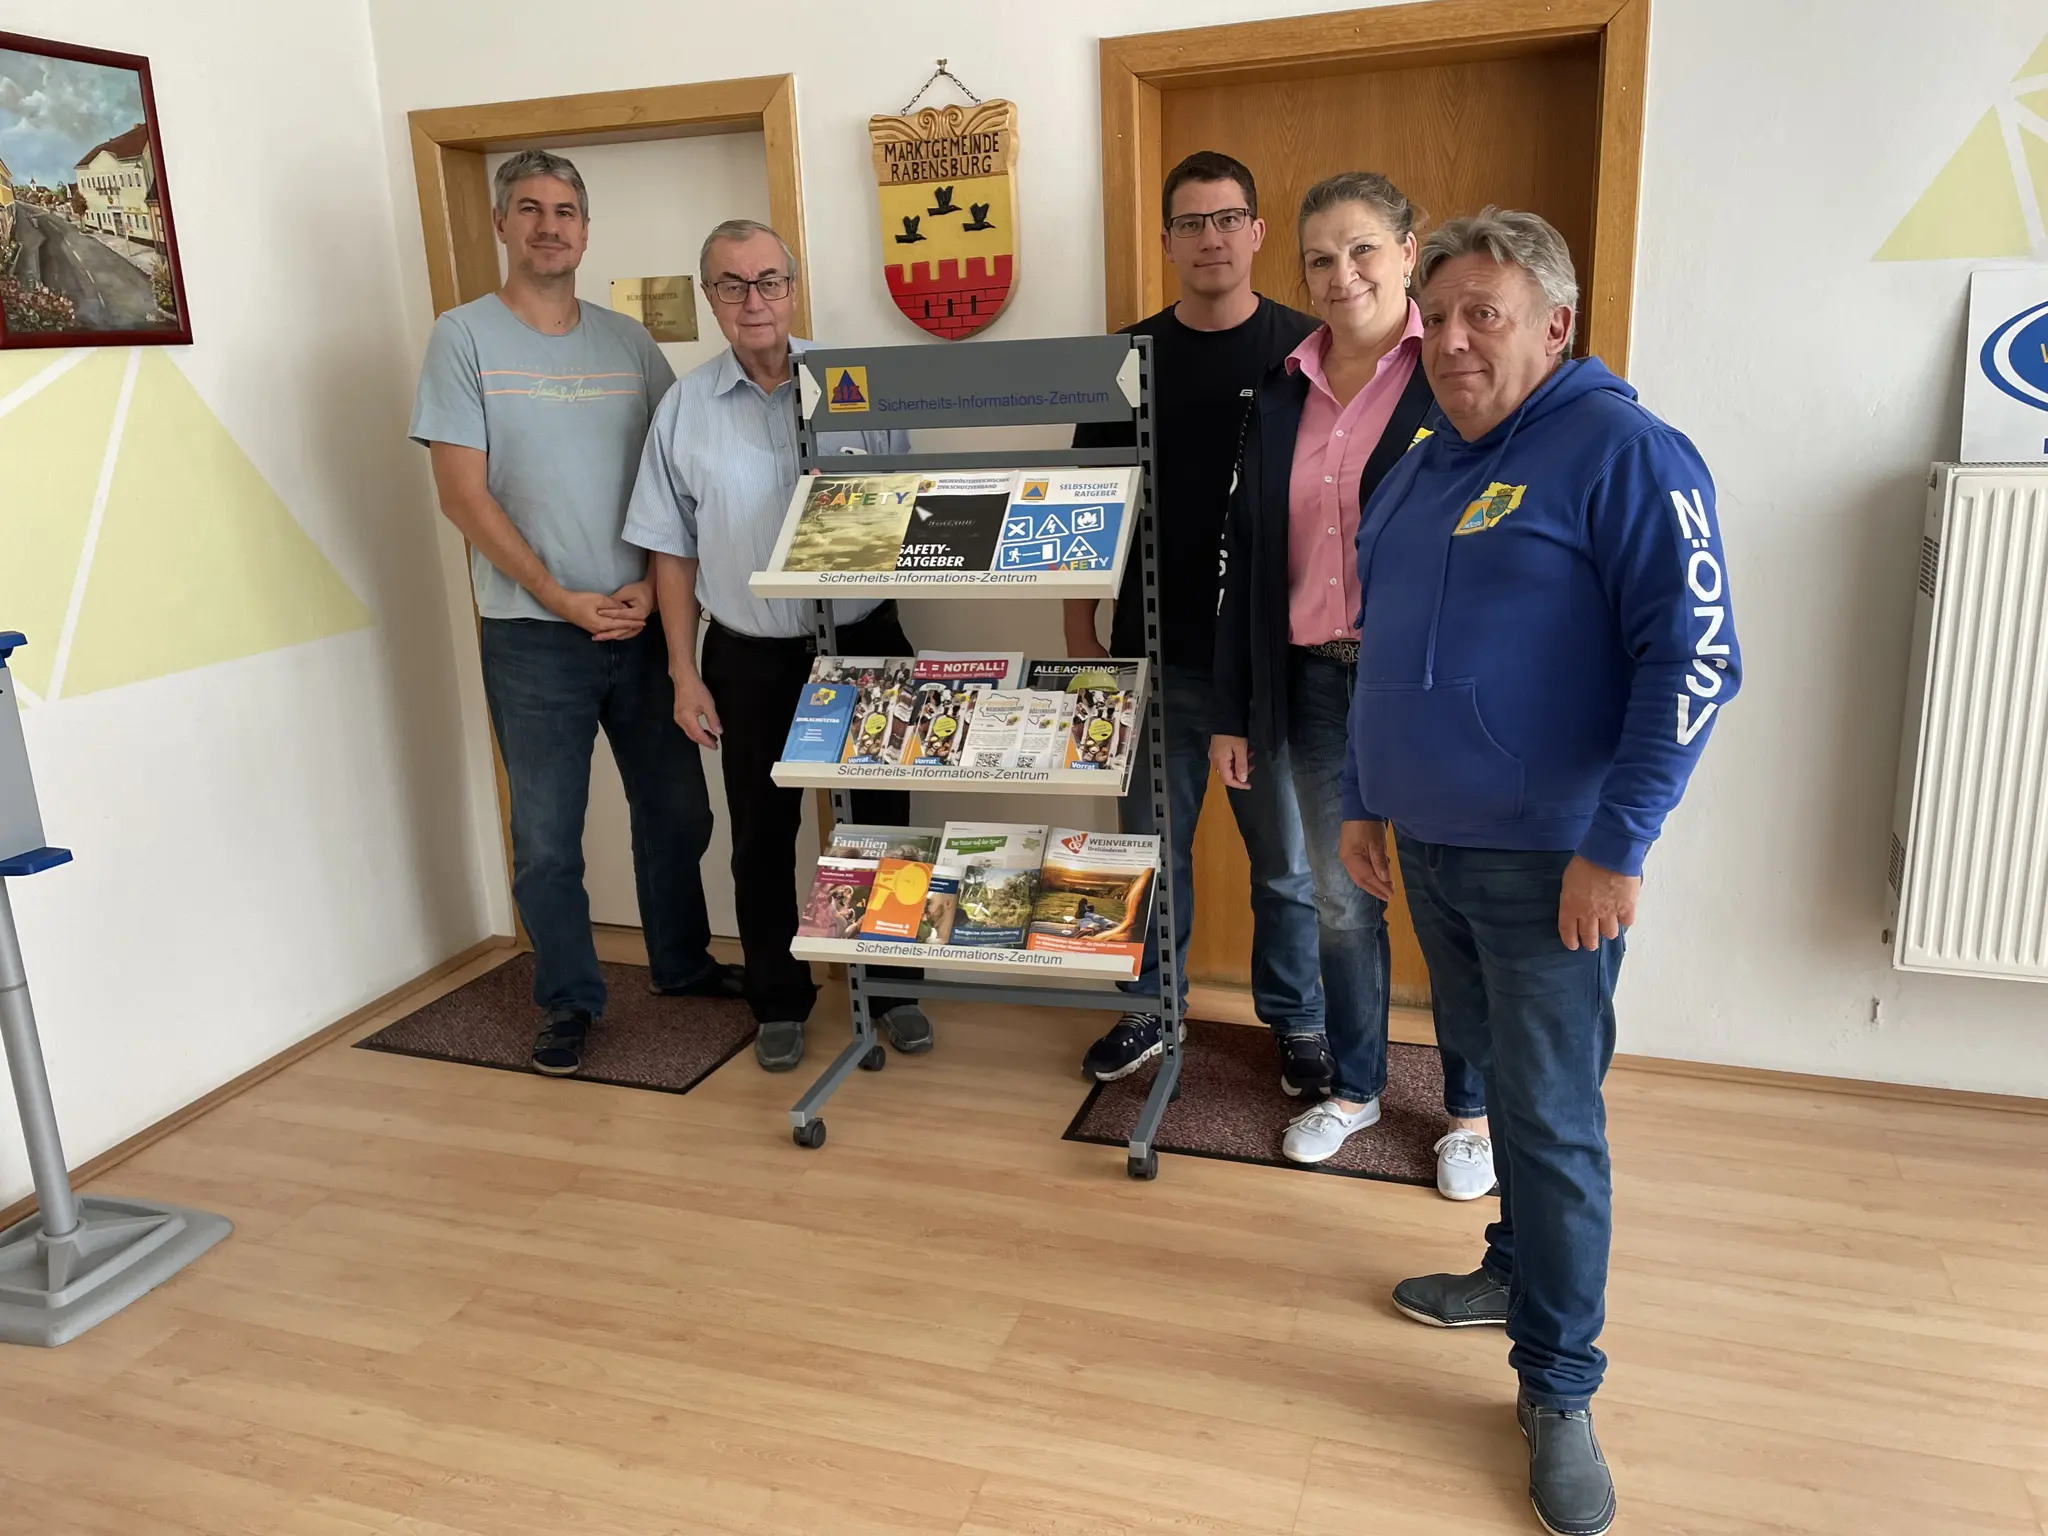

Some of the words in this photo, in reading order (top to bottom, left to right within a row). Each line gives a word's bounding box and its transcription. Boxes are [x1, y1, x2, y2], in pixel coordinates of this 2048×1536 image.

[884, 132, 1000, 163] MARKTGEMEINDE
[891, 155, 992, 182] RABENSBURG
[877, 390, 1110, 412] Sicherheits-Informations-Zentrum
[1060, 482, 1118, 490] SELBSTSCHUTZ
[816, 491, 910, 507] SAFETY
[896, 556, 965, 567] RATGEBER
[818, 572, 1037, 585] Sicherheits-Informations-Zentrum
[1669, 488, 1731, 746] NÖZSV
[943, 662, 1005, 672] NOTFALL!
[1071, 761, 1096, 770] Vorrat
[837, 765, 1050, 782] Sicherheits-Informations-Zentrum
[832, 836, 888, 850] Familien
[1089, 838, 1153, 848] WEINVIERTLER
[862, 849, 886, 858] zeit
[855, 941, 1063, 966] Sicherheits-Informations-Zentrum
